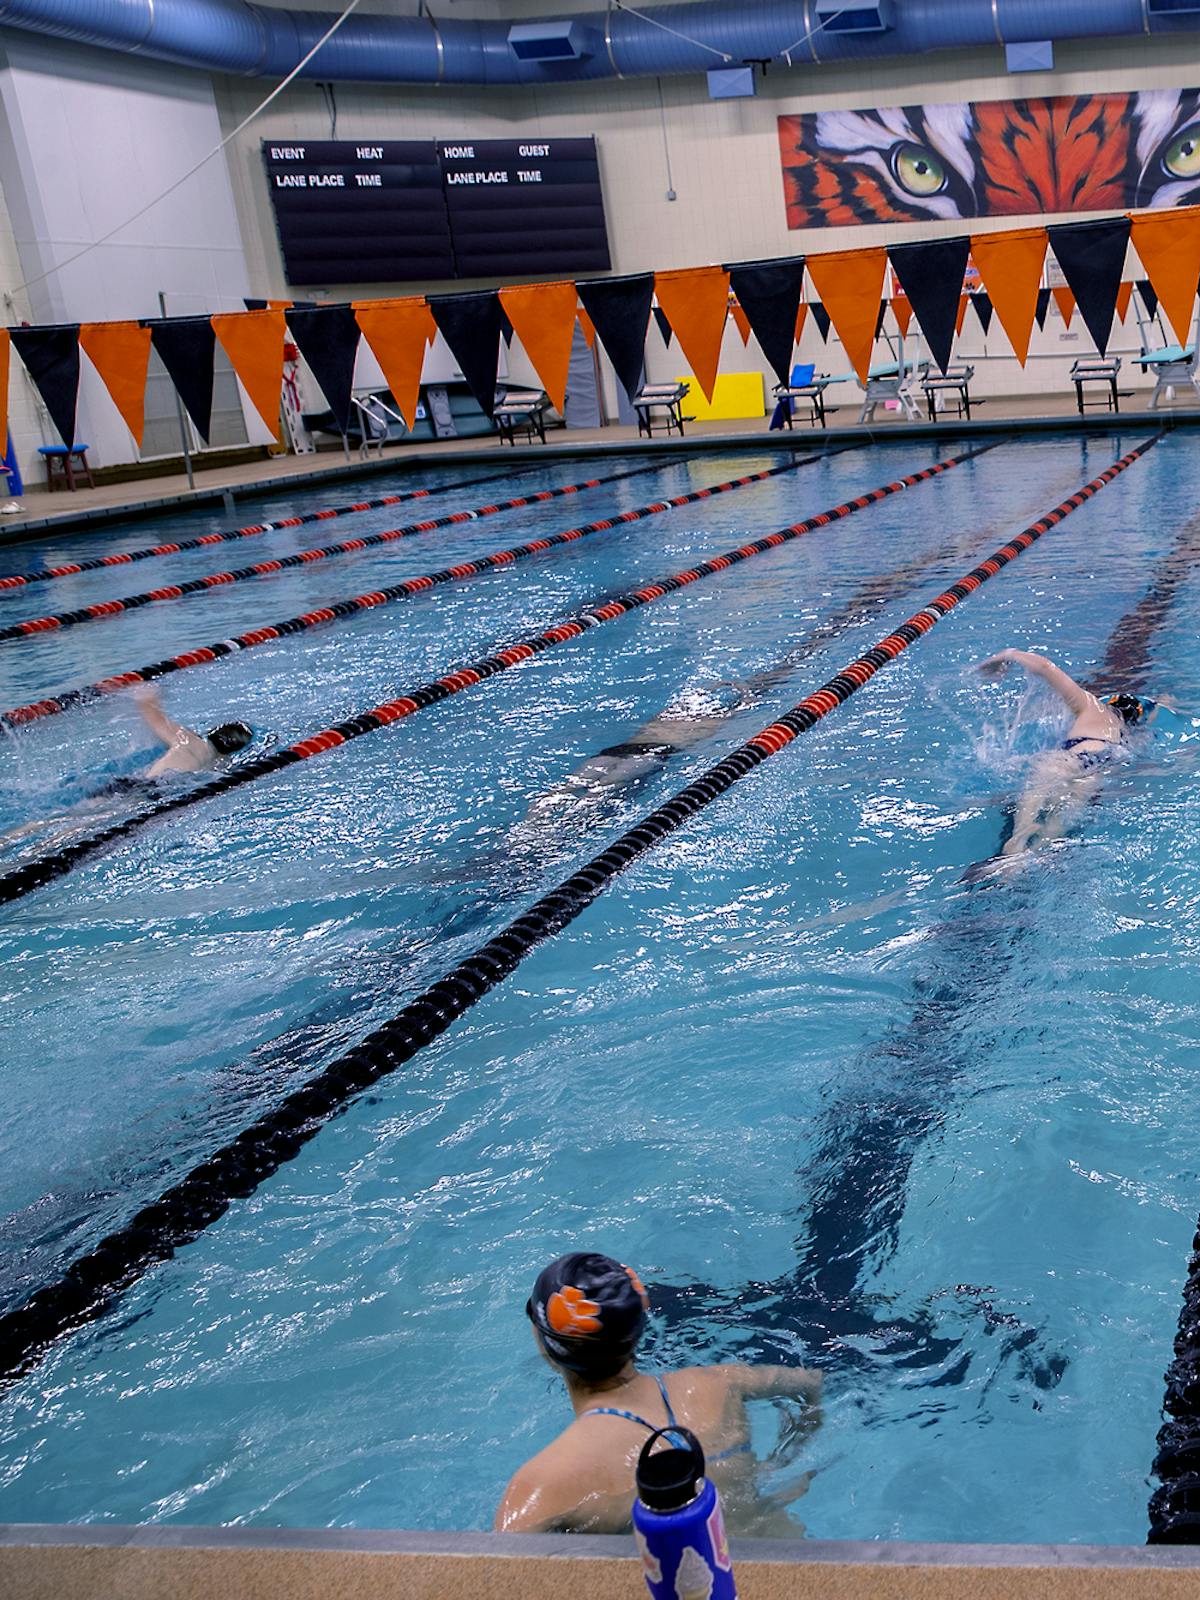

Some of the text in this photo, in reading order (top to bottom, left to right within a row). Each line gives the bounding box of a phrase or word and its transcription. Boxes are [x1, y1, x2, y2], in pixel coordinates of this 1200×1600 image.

[270, 147, 384, 160] EVENT HEAT
[444, 145, 550, 159] HOME GUEST
[276, 174, 382, 187] LANE PLACE TIME
[446, 170, 542, 184] LANE PLACE TIME
